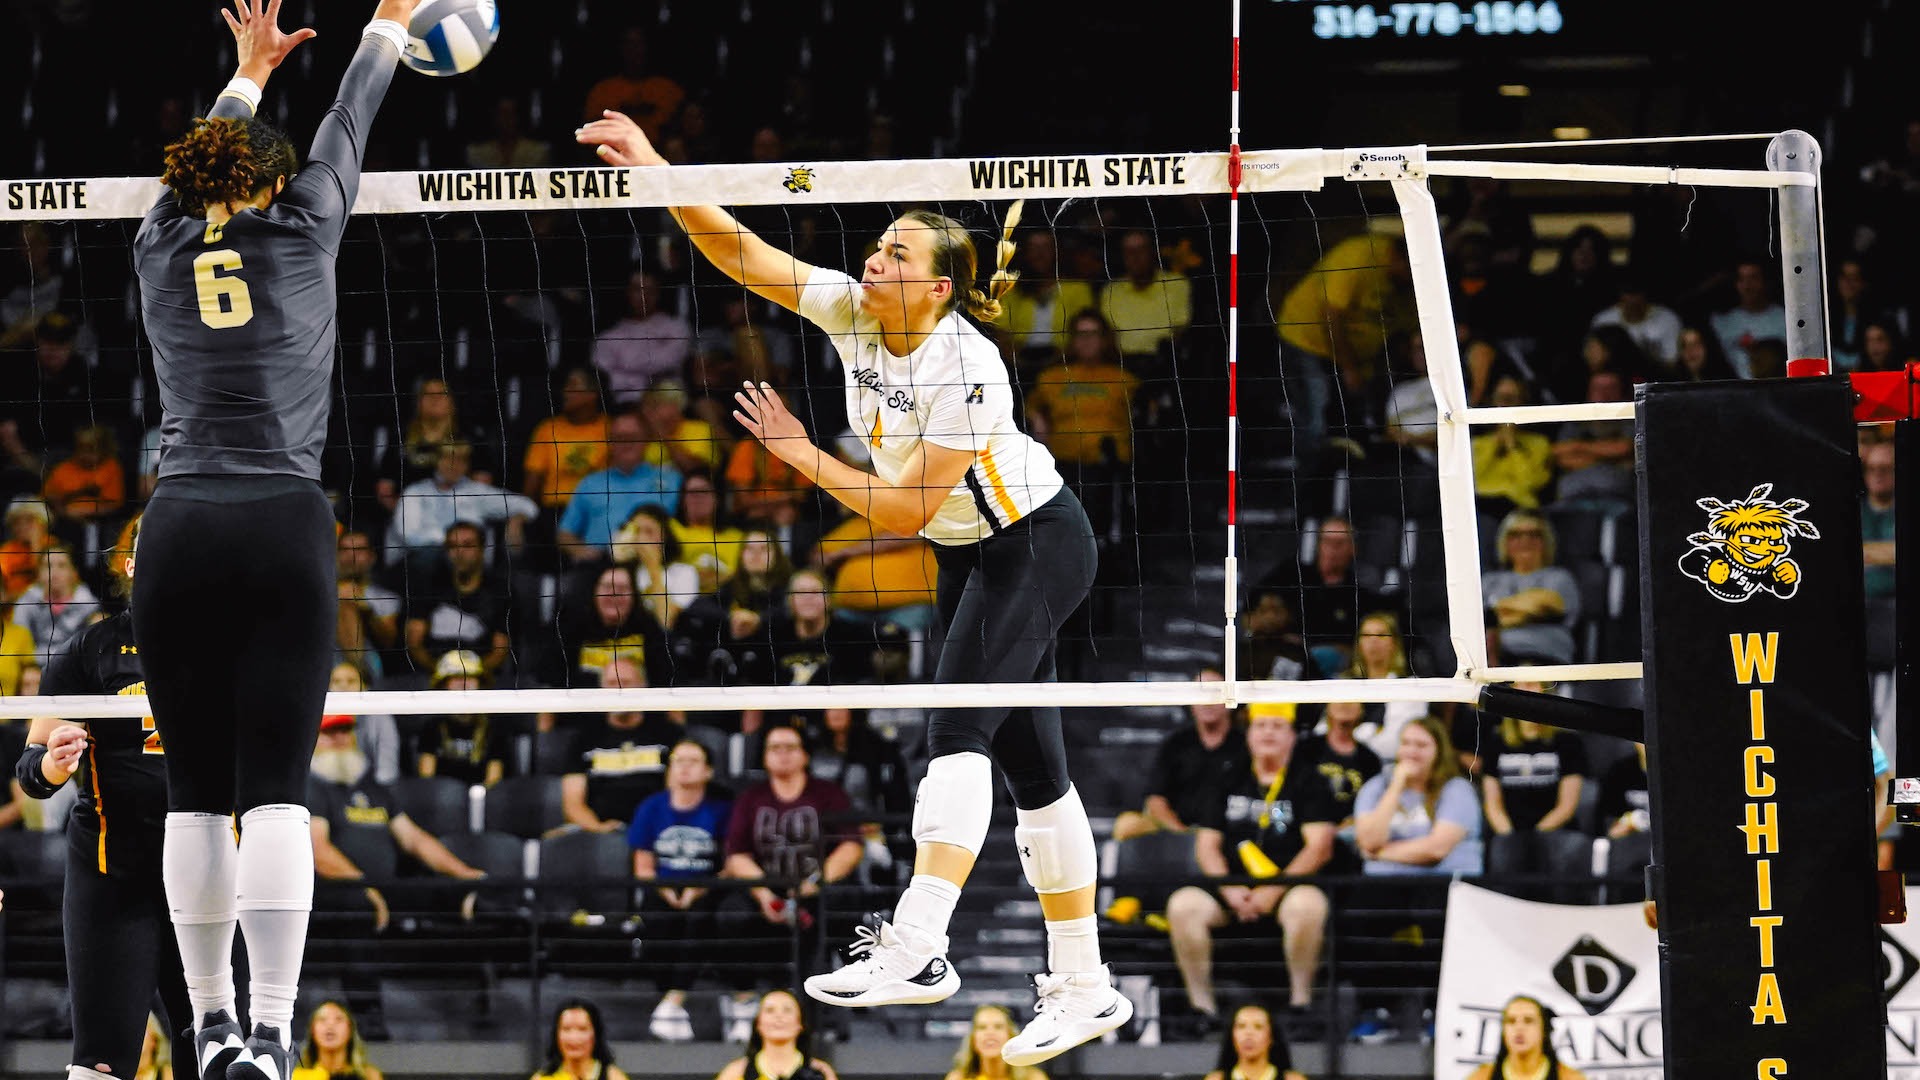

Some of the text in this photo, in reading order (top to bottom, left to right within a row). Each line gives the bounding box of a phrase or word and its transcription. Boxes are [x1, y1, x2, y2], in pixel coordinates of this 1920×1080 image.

[969, 156, 1186, 189] WICHITA STATE
[1369, 154, 1406, 162] Senoh
[8, 181, 87, 210] STATE
[418, 169, 630, 202] WICHITA STATE
[193, 248, 254, 330] 6
[1729, 567, 1755, 593] WSU
[1729, 631, 1788, 1026] WICHITA
